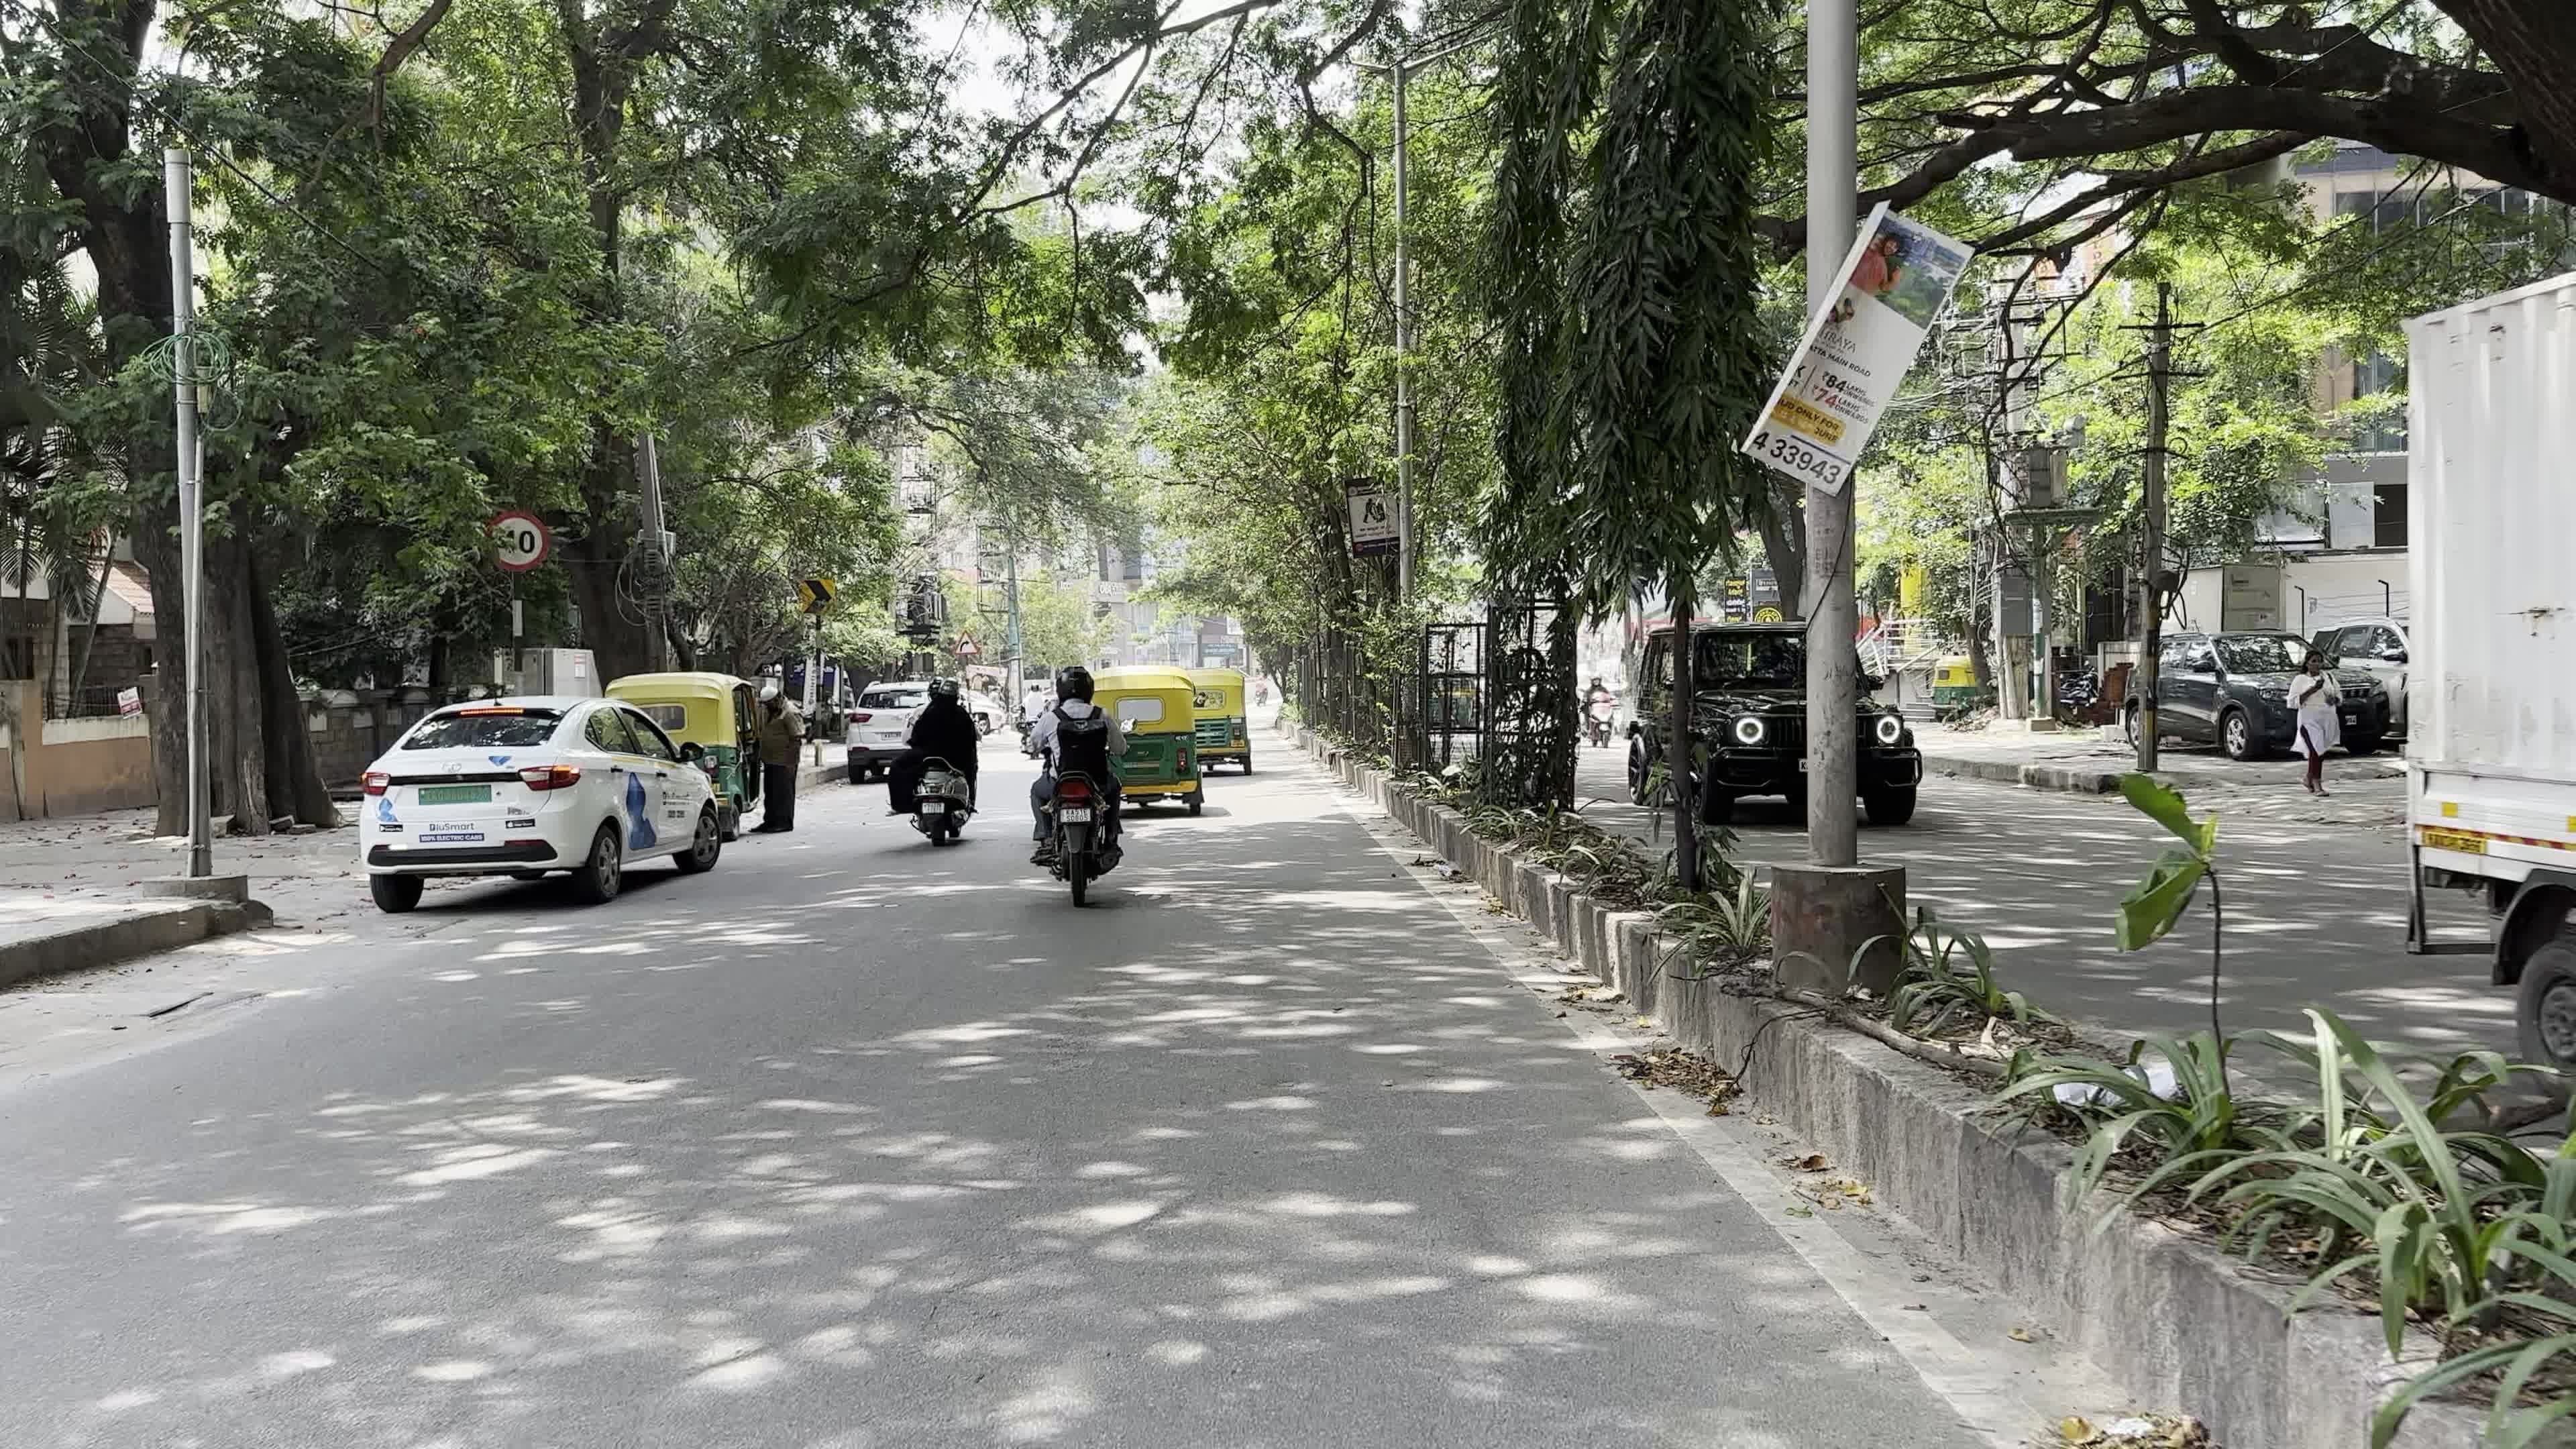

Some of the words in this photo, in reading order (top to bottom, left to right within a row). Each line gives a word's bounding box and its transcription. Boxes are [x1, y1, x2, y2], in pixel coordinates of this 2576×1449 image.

[1827, 354, 1849, 367] MAIN
[1848, 363, 1871, 376] ROAD
[1796, 406, 1820, 422] ONLY
[1820, 417, 1840, 431] FOR
[1835, 404, 1868, 424] ONWARDS
[1753, 431, 1770, 451] 4
[1770, 439, 1841, 484] 33943
